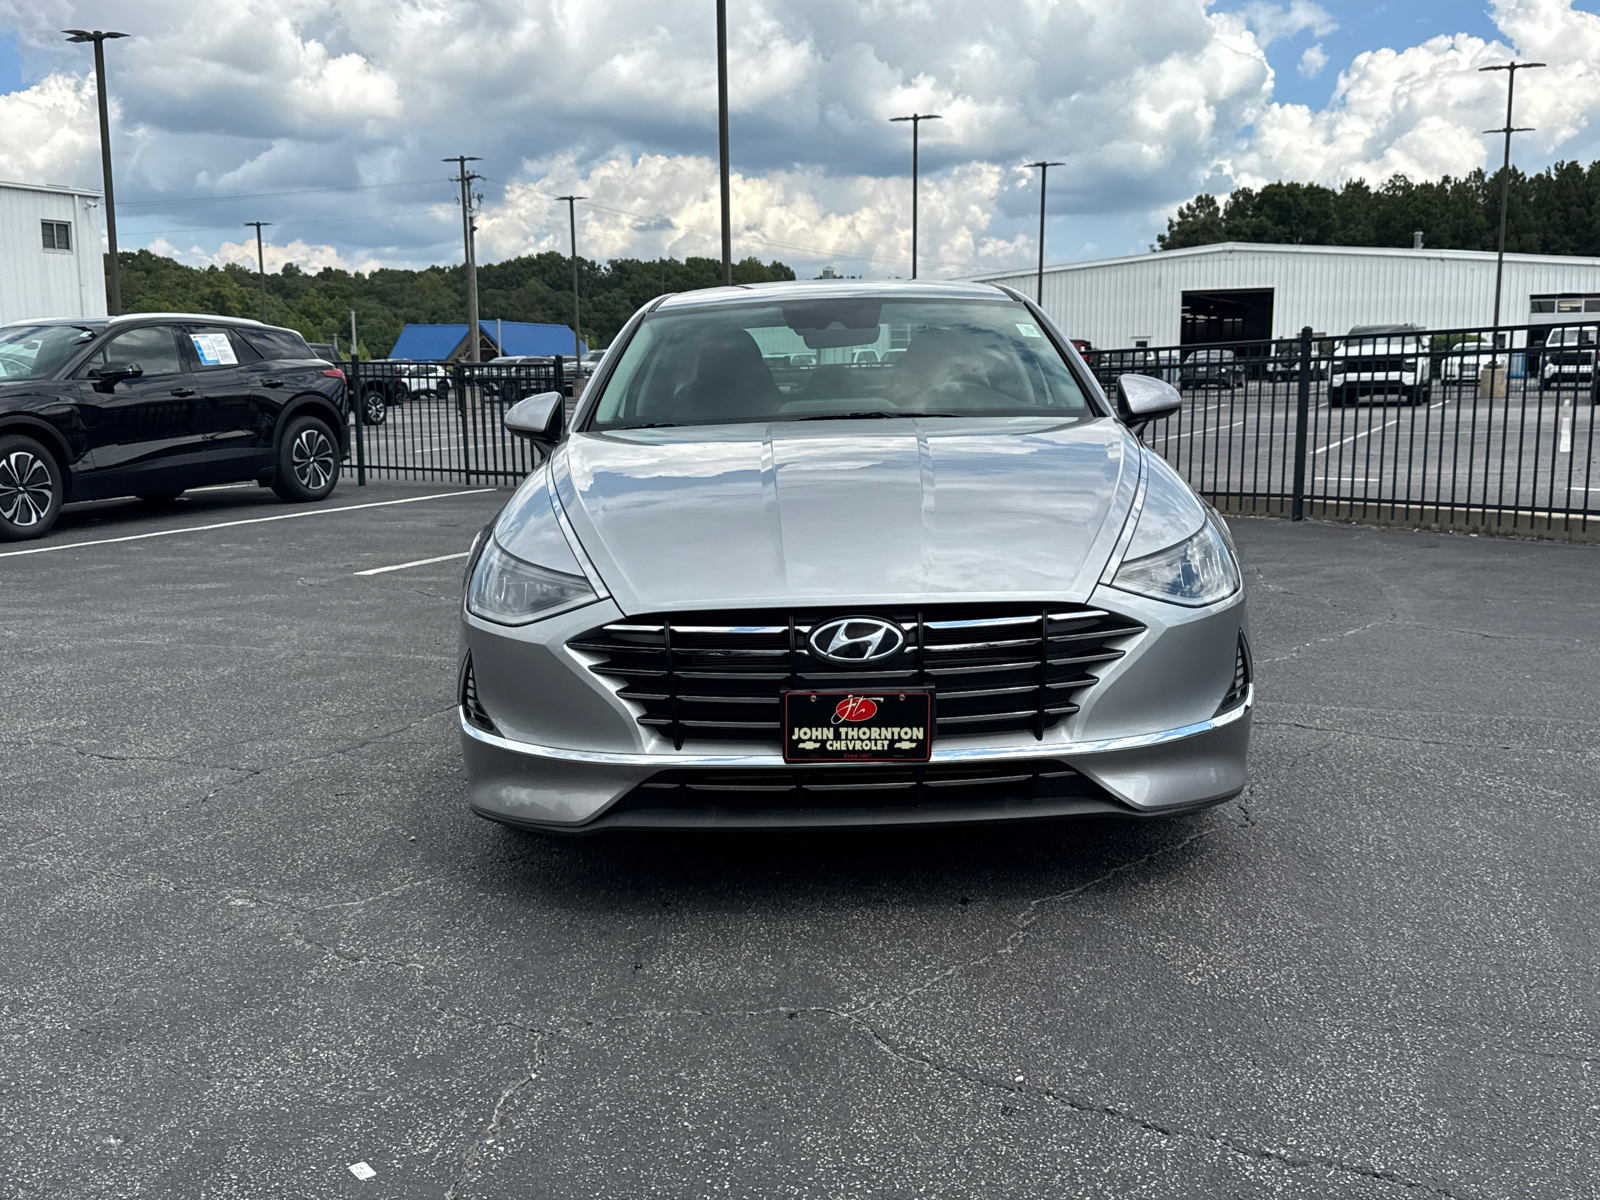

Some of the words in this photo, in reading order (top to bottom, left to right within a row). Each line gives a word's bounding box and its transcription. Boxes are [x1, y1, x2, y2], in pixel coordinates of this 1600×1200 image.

[791, 727, 834, 740] JOHN
[839, 727, 924, 740] THORNTON
[826, 740, 889, 750] CHEVROLET
